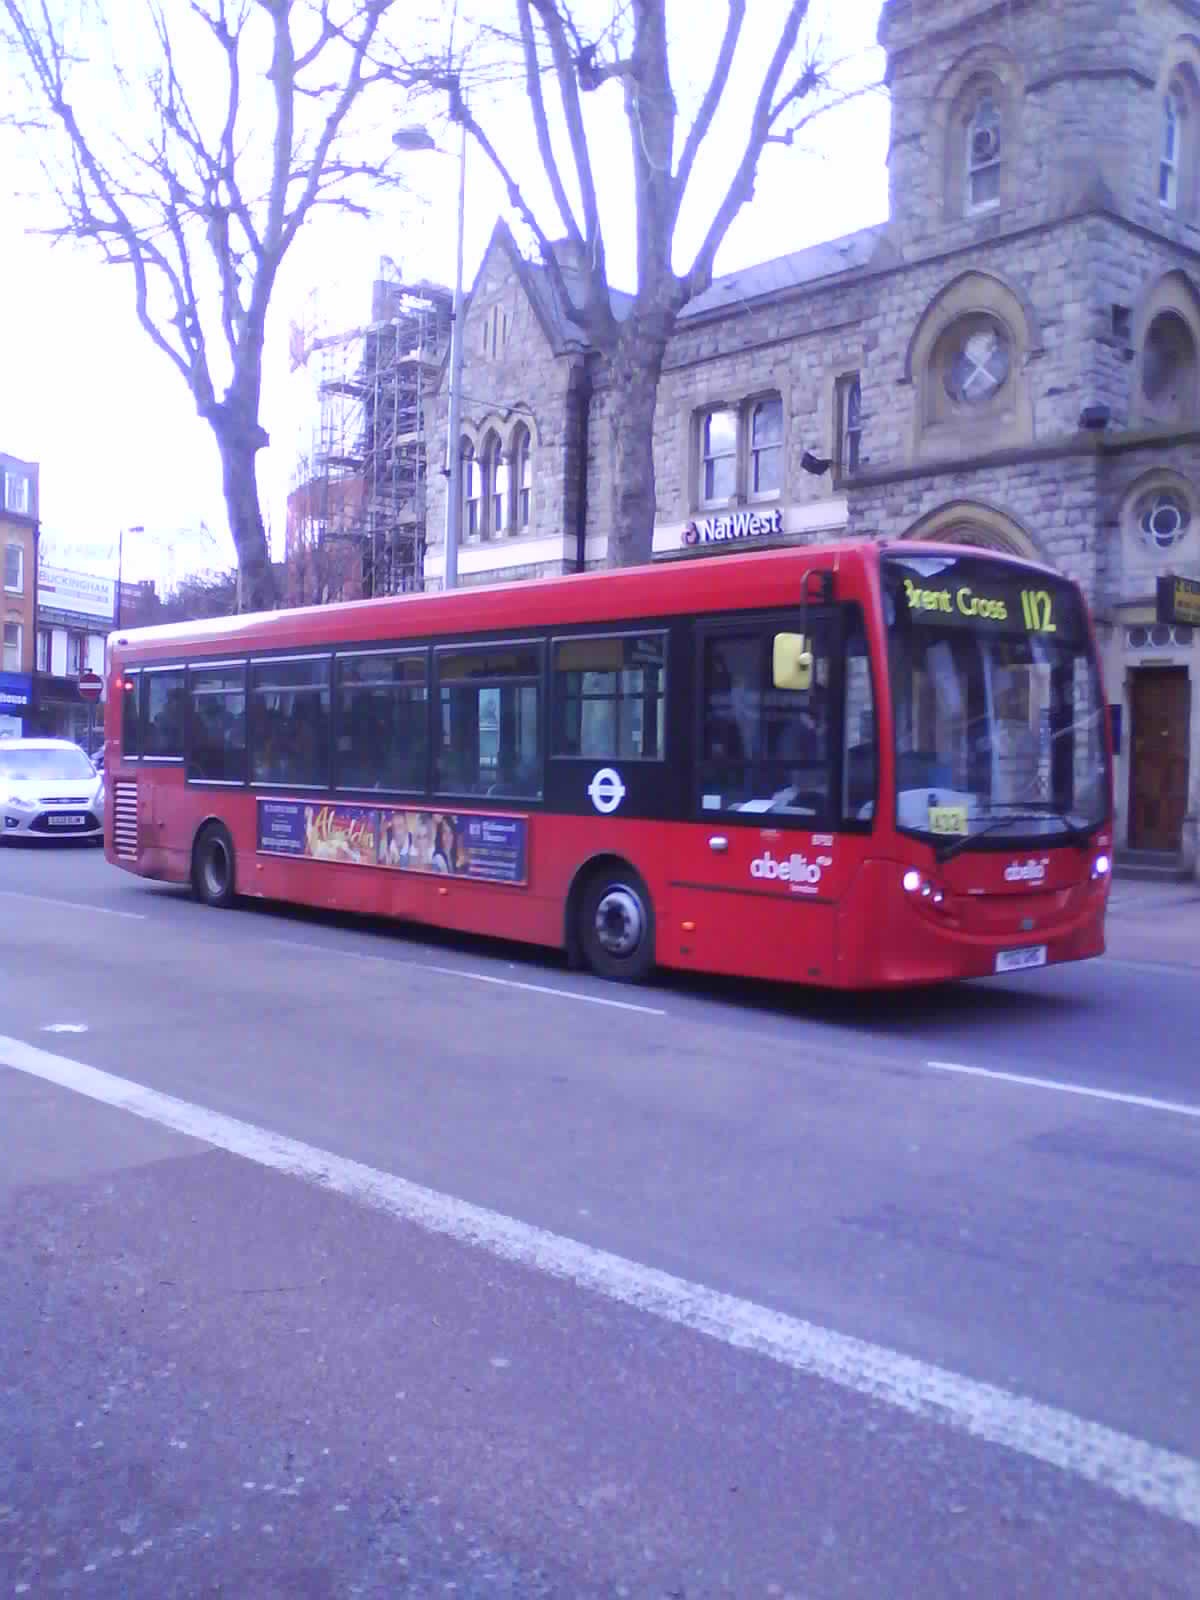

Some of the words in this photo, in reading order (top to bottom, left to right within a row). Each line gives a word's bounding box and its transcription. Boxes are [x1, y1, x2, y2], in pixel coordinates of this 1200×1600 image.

[702, 510, 781, 542] NatWest
[39, 570, 109, 593] BUCKINGHAM
[957, 587, 1008, 621] Cross
[1020, 589, 1057, 633] 112
[750, 850, 822, 884] abellio
